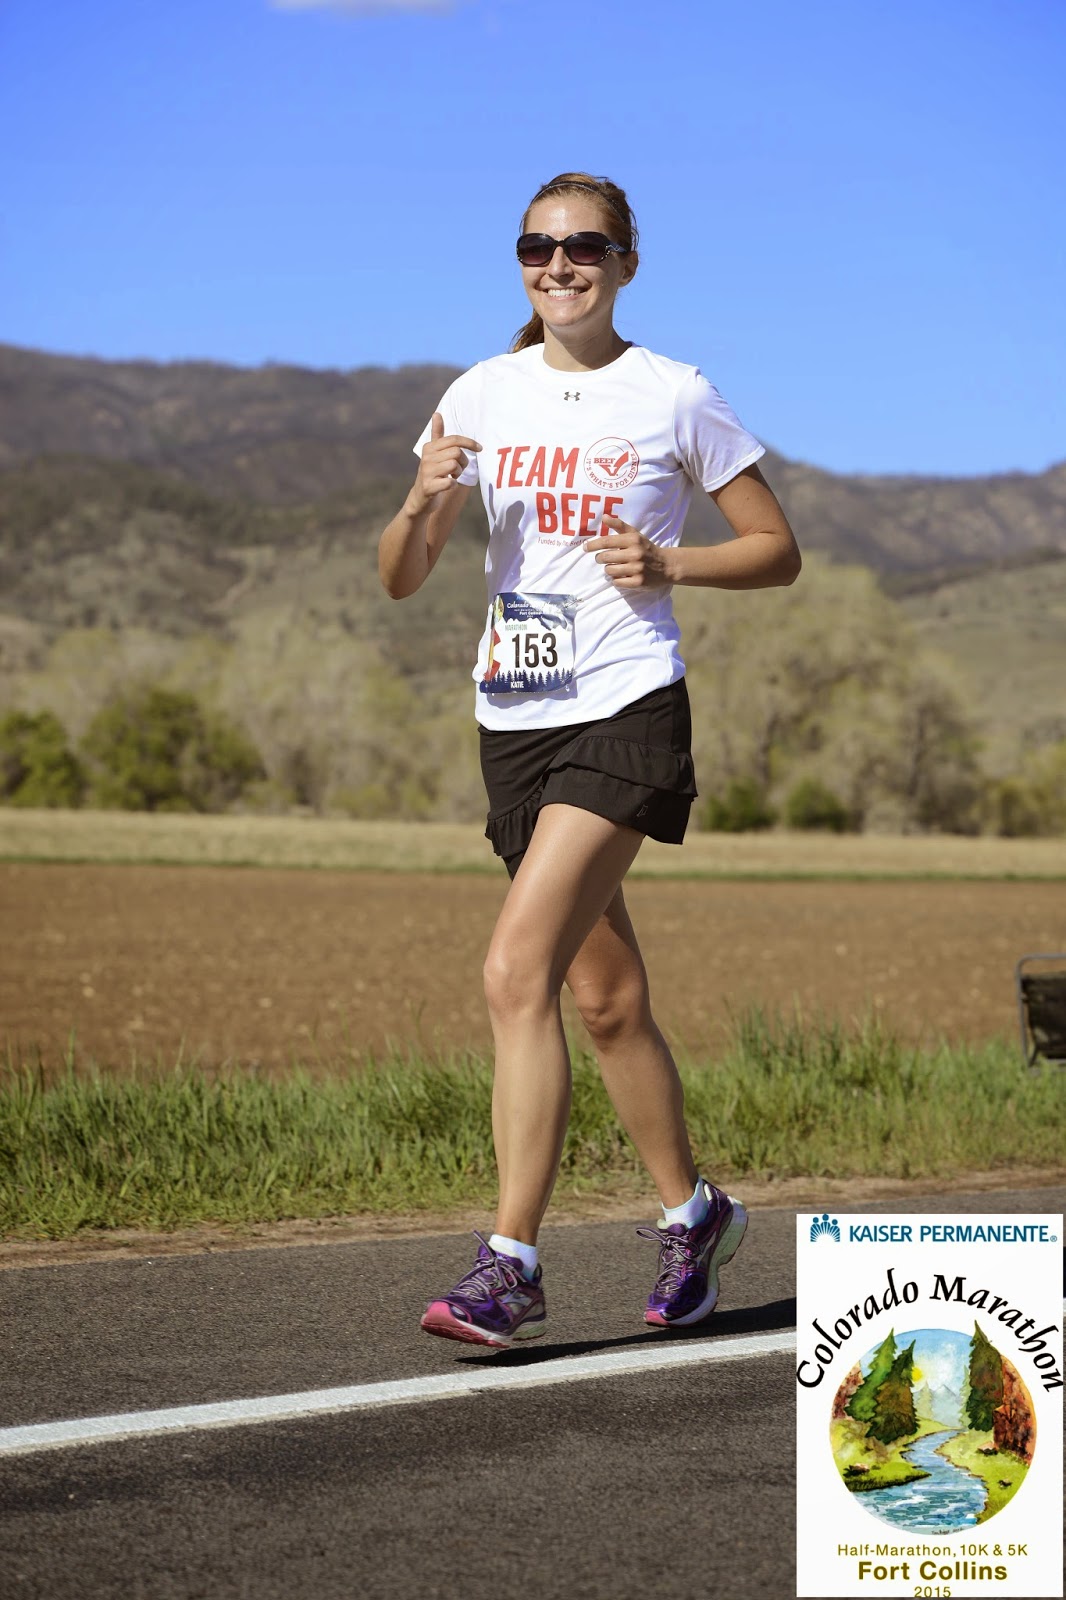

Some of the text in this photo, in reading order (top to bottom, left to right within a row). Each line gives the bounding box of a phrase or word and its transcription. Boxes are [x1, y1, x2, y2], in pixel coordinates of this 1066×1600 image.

[496, 446, 580, 489] TEAM
[589, 471, 613, 488] WHAT'S
[615, 478, 629, 488] FOR
[536, 492, 624, 537] BEEF
[538, 536, 556, 545] Funded
[507, 600, 529, 608] Colorado
[512, 632, 558, 668] 153
[510, 680, 525, 689] KATIE
